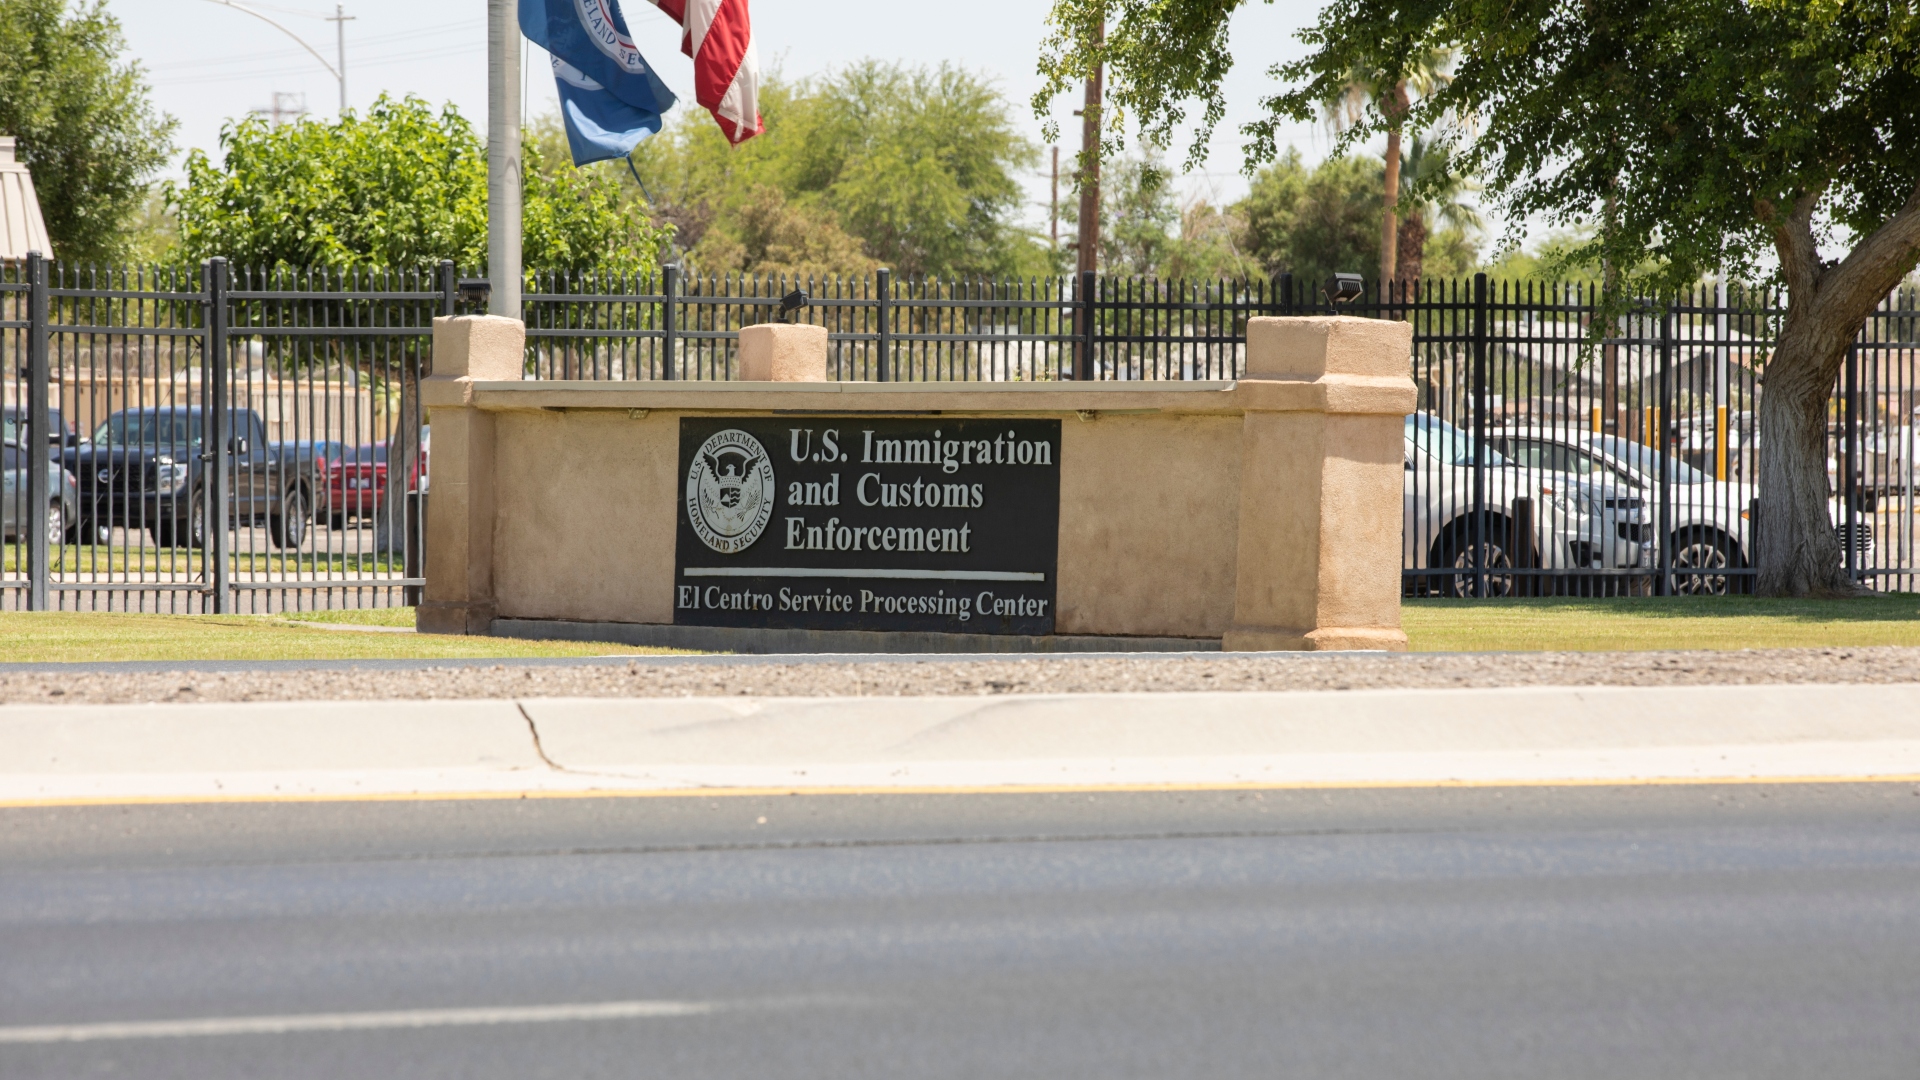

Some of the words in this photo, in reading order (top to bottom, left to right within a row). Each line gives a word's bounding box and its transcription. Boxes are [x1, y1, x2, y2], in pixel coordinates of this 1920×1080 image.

[690, 460, 704, 480] U.S.
[704, 432, 768, 464] DEPARTMENT
[762, 465, 773, 482] OF
[789, 428, 848, 463] U.S.
[860, 429, 1053, 474] Immigration
[787, 473, 840, 506] and
[856, 472, 984, 508] Customs
[688, 497, 730, 550] HOMELAND
[733, 497, 772, 550] SECURITY
[783, 516, 972, 553] Enforcement
[677, 585, 700, 609] El
[704, 585, 773, 611] Centro
[778, 587, 853, 613] Service
[860, 589, 972, 621] Processing
[975, 591, 1049, 617] Center
